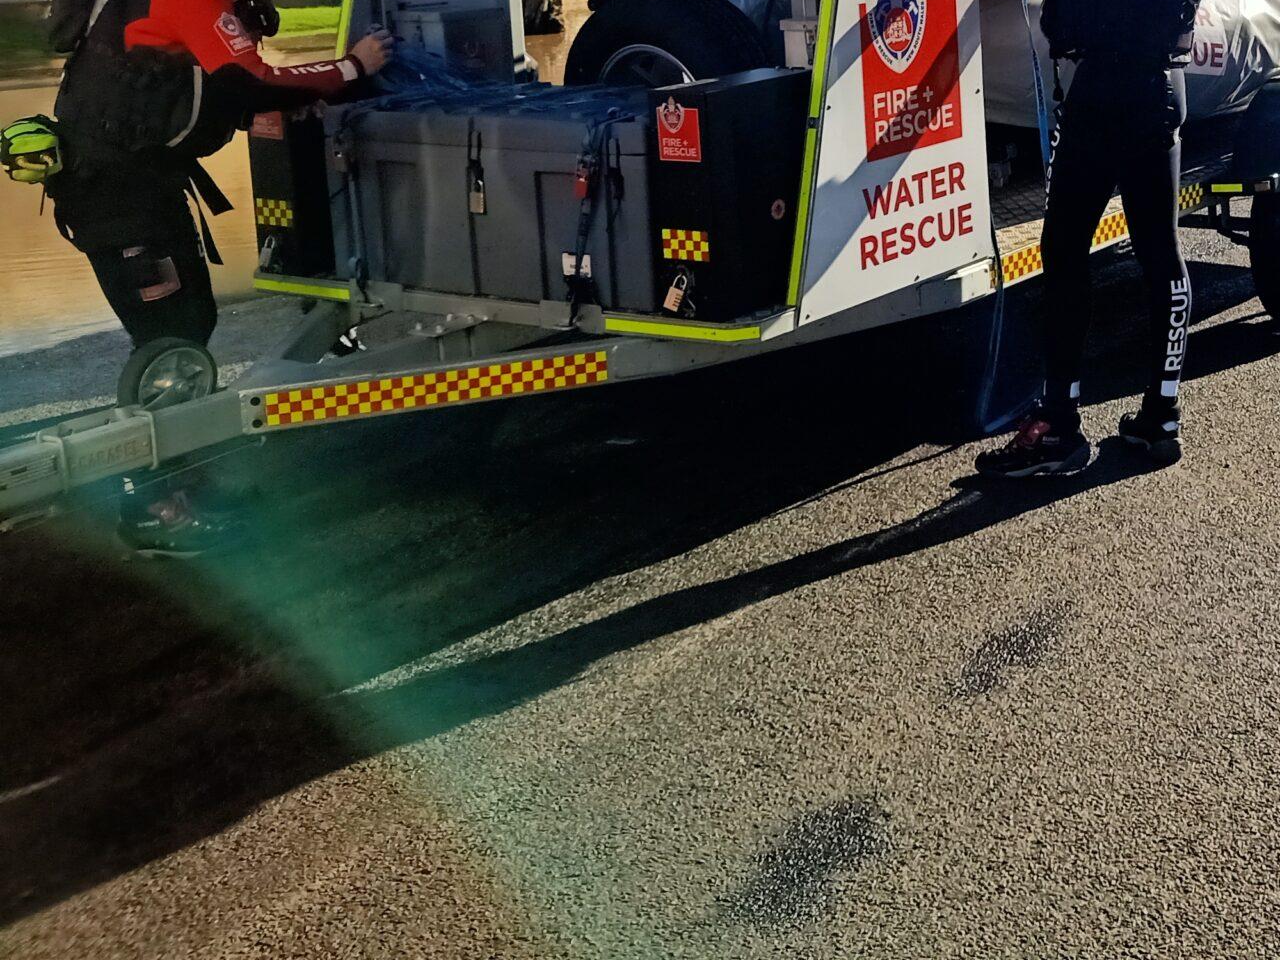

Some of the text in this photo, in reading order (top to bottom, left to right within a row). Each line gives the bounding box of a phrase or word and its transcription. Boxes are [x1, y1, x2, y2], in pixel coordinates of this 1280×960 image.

[873, 85, 919, 118] FIRE
[663, 138, 682, 147] FIRE
[875, 103, 954, 146] RESCUE
[663, 147, 698, 157] RESCUE
[862, 161, 966, 220] WATER
[861, 203, 974, 271] RESCUE
[1164, 277, 1189, 371] RESCUE
